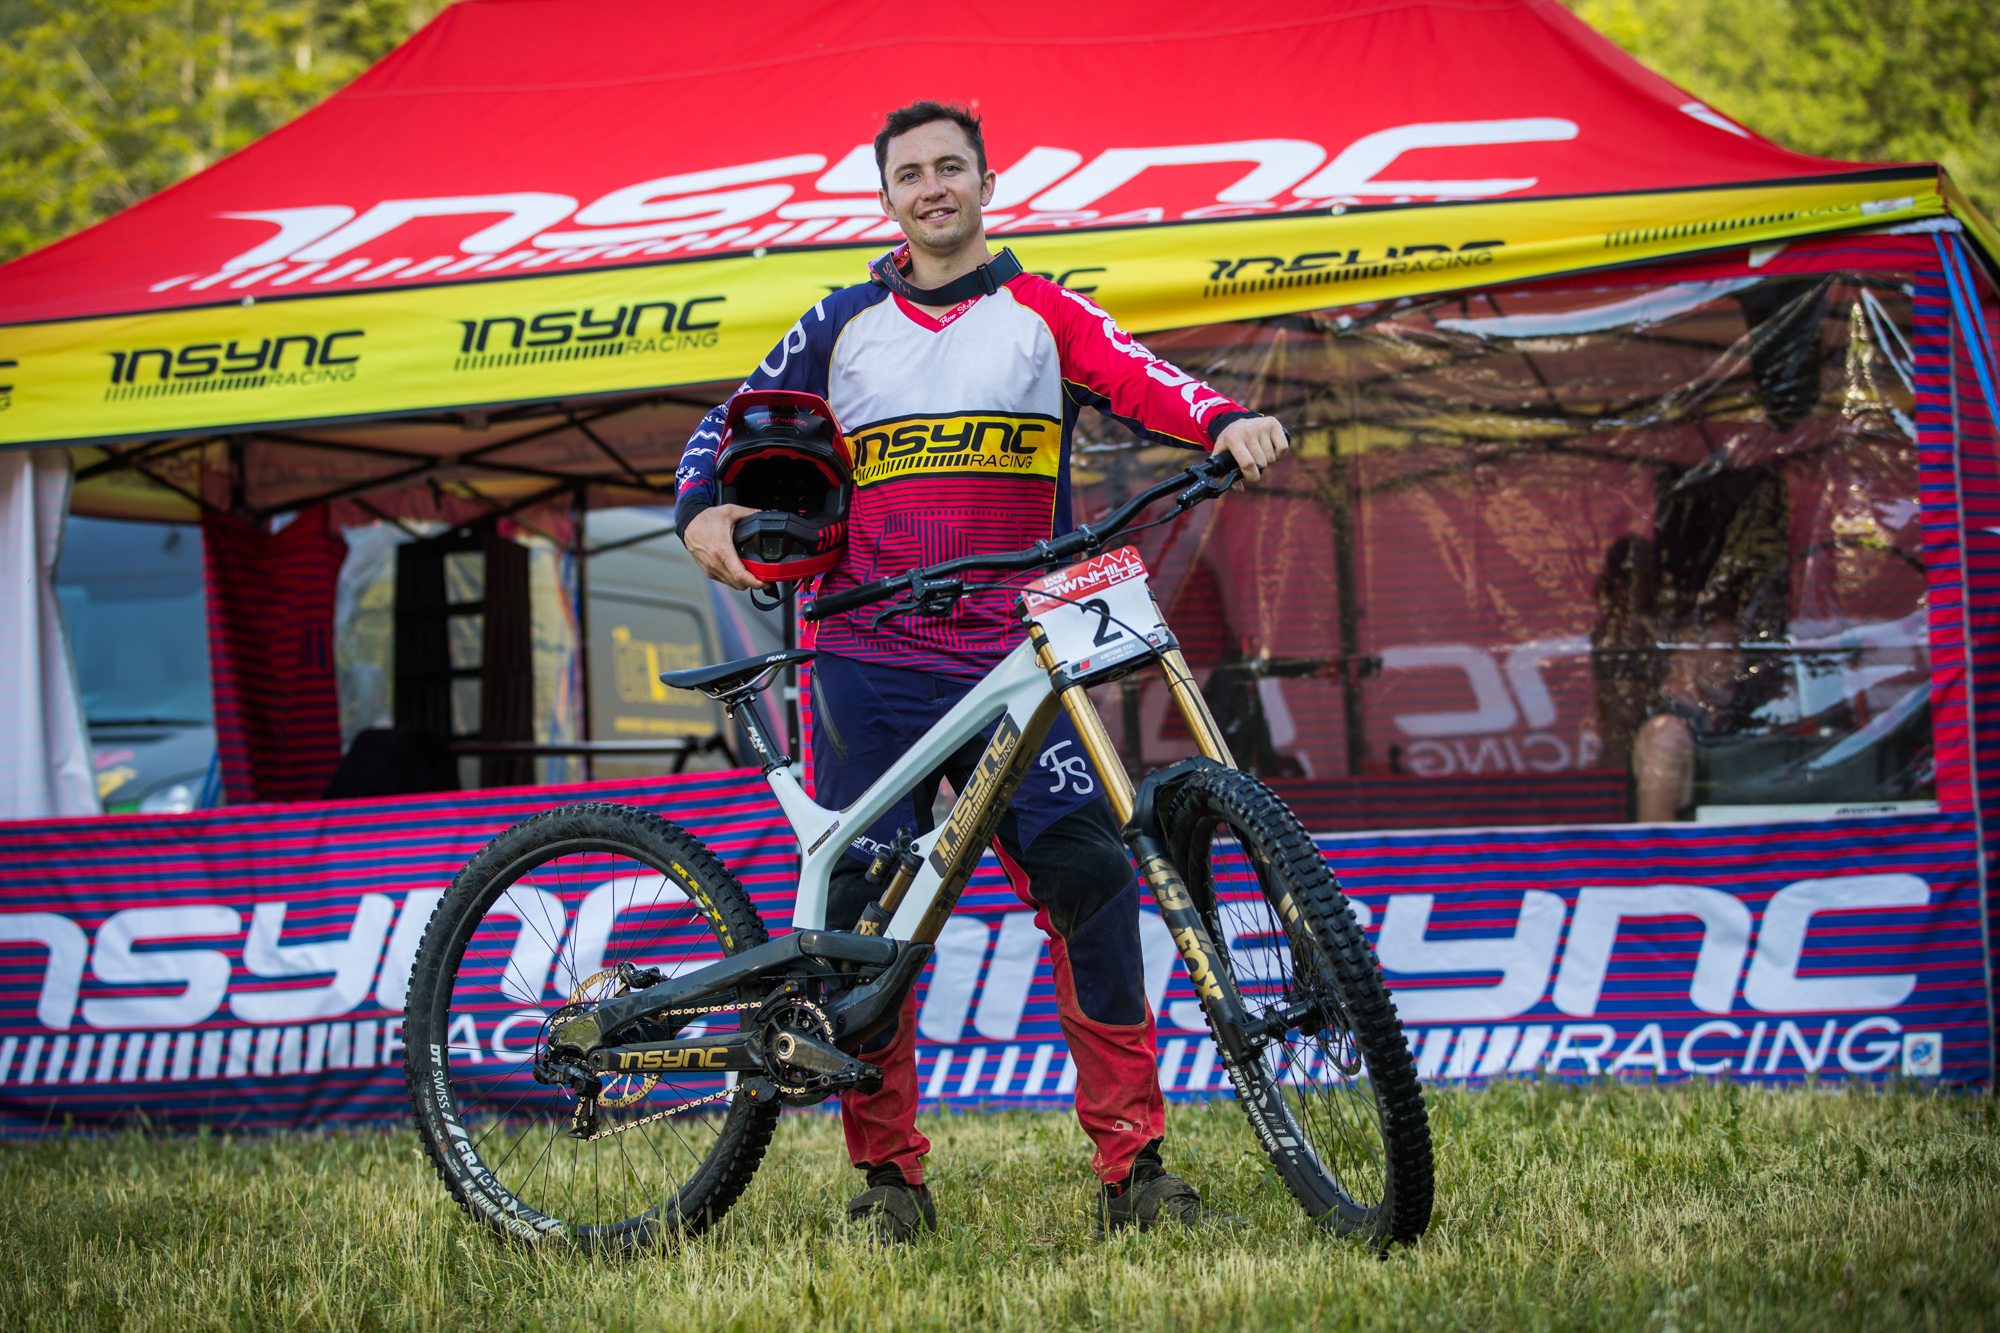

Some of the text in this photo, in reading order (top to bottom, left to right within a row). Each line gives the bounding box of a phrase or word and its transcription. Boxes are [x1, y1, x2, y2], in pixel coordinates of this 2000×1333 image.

[882, 261, 911, 295] SMITH
[1389, 250, 1494, 277] RACING
[939, 298, 976, 327] Flow Style
[623, 331, 719, 357] RACING
[264, 366, 357, 388] RACING
[969, 454, 1033, 469] RACING
[1027, 558, 1141, 608] DOWNHILL
[1108, 565, 1143, 585] CUP
[1080, 598, 1123, 648] 2
[766, 654, 787, 663] FUNN
[748, 726, 767, 753] FUNN
[989, 736, 1016, 785] RACING
[871, 859, 883, 876] FOX
[671, 861, 735, 950] MAXXIS
[1175, 926, 1225, 1007] FOX
[430, 1043, 442, 1066] DT
[1550, 1017, 1902, 1078] RACING
[432, 1069, 450, 1109] SWISS
[1230, 1065, 1250, 1099] DHR
[1248, 1099, 1280, 1154] MINION
